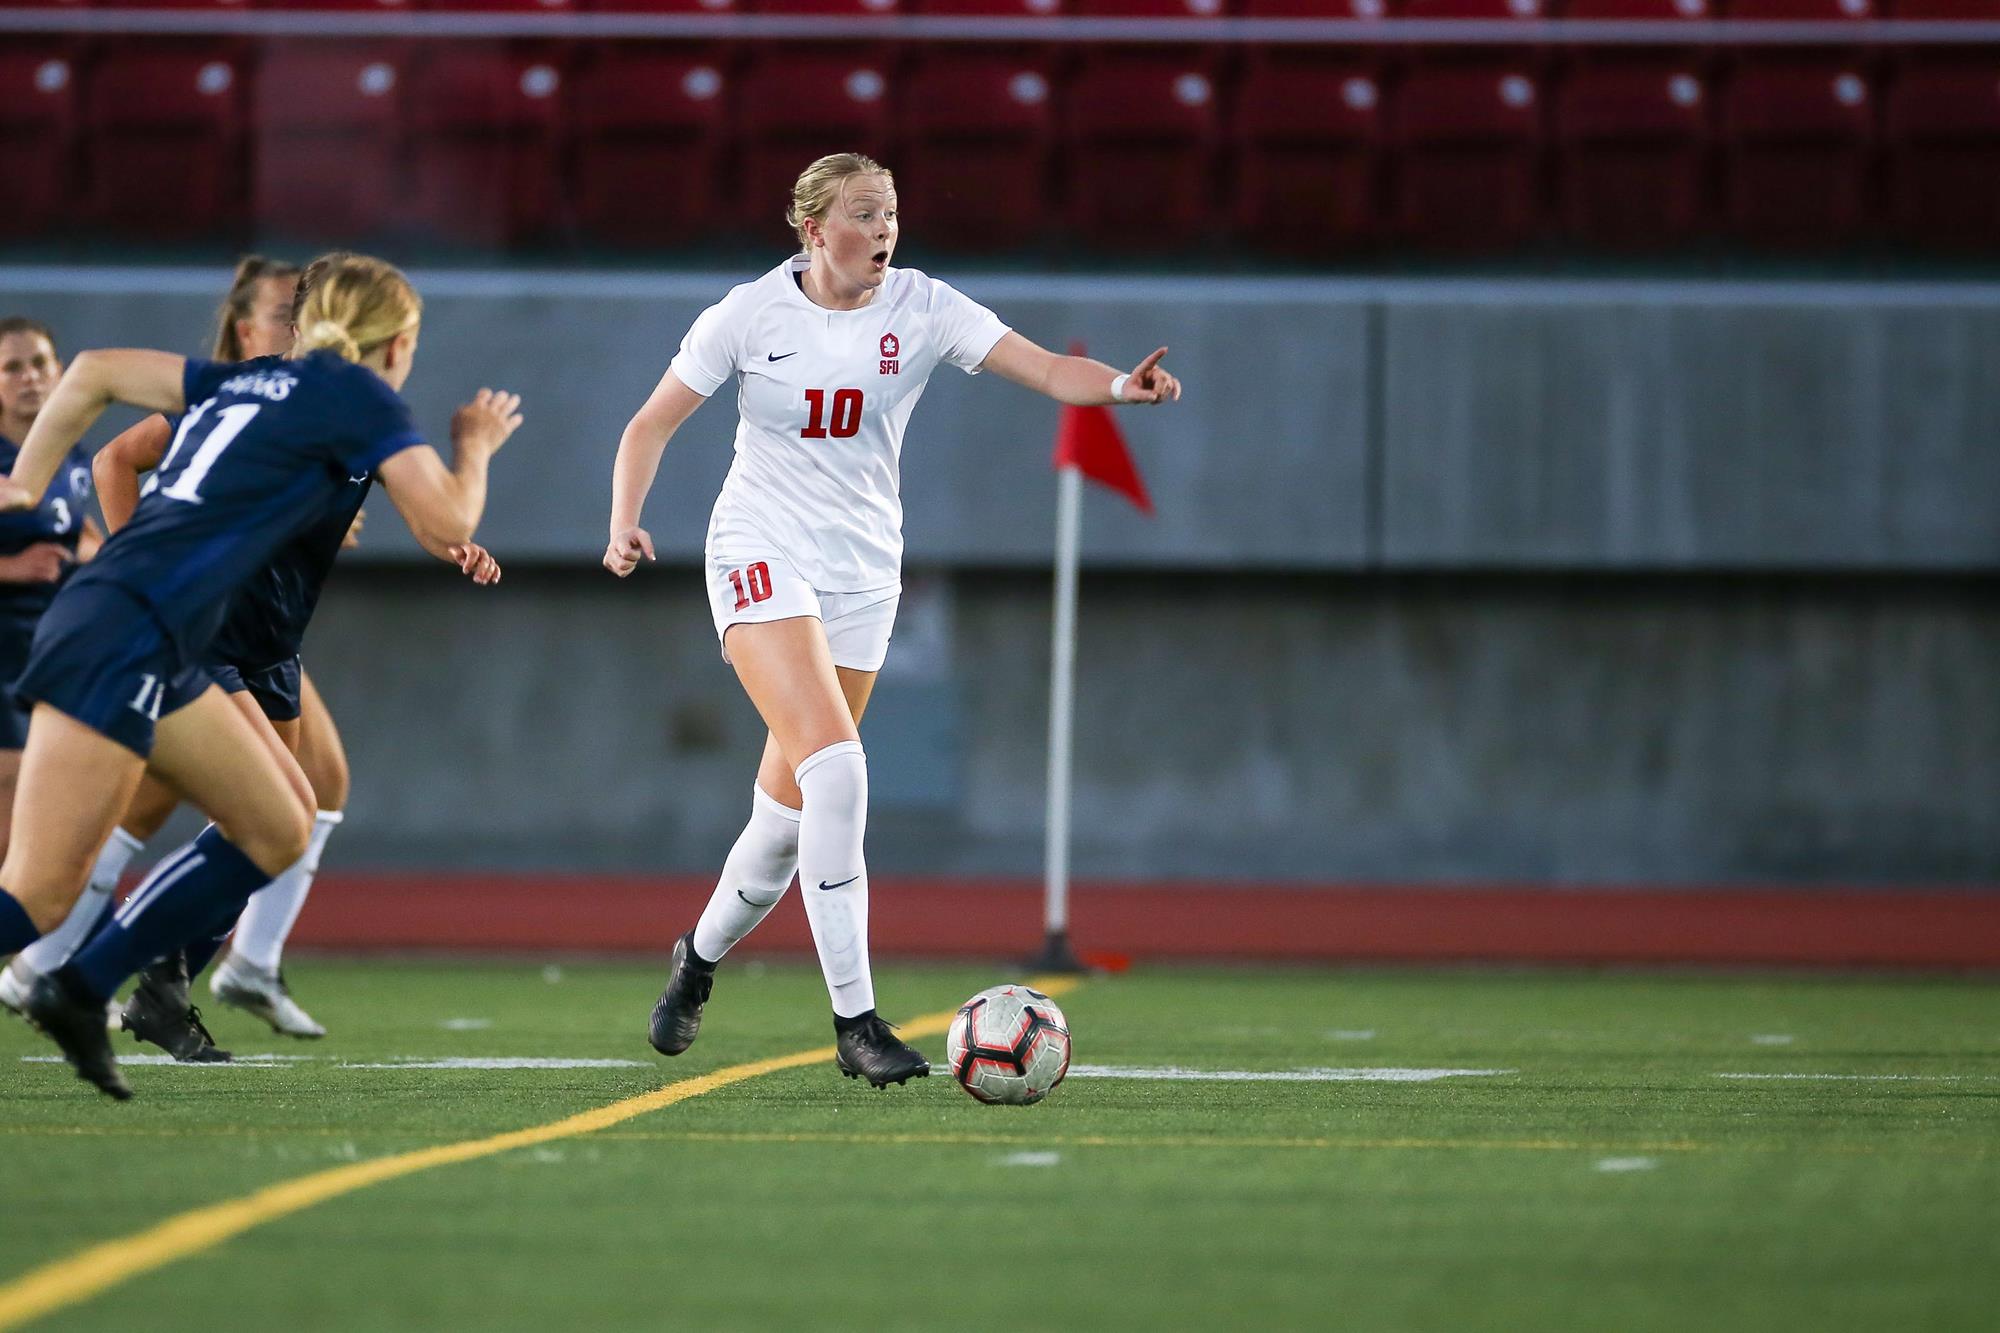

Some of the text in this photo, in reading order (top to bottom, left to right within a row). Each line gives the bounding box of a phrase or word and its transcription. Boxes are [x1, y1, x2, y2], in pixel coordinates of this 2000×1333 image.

[879, 360, 899, 375] SFU
[801, 388, 864, 439] 10
[139, 397, 262, 504] 11
[51, 497, 72, 534] 3
[728, 561, 773, 613] 10
[128, 673, 165, 721] 11
